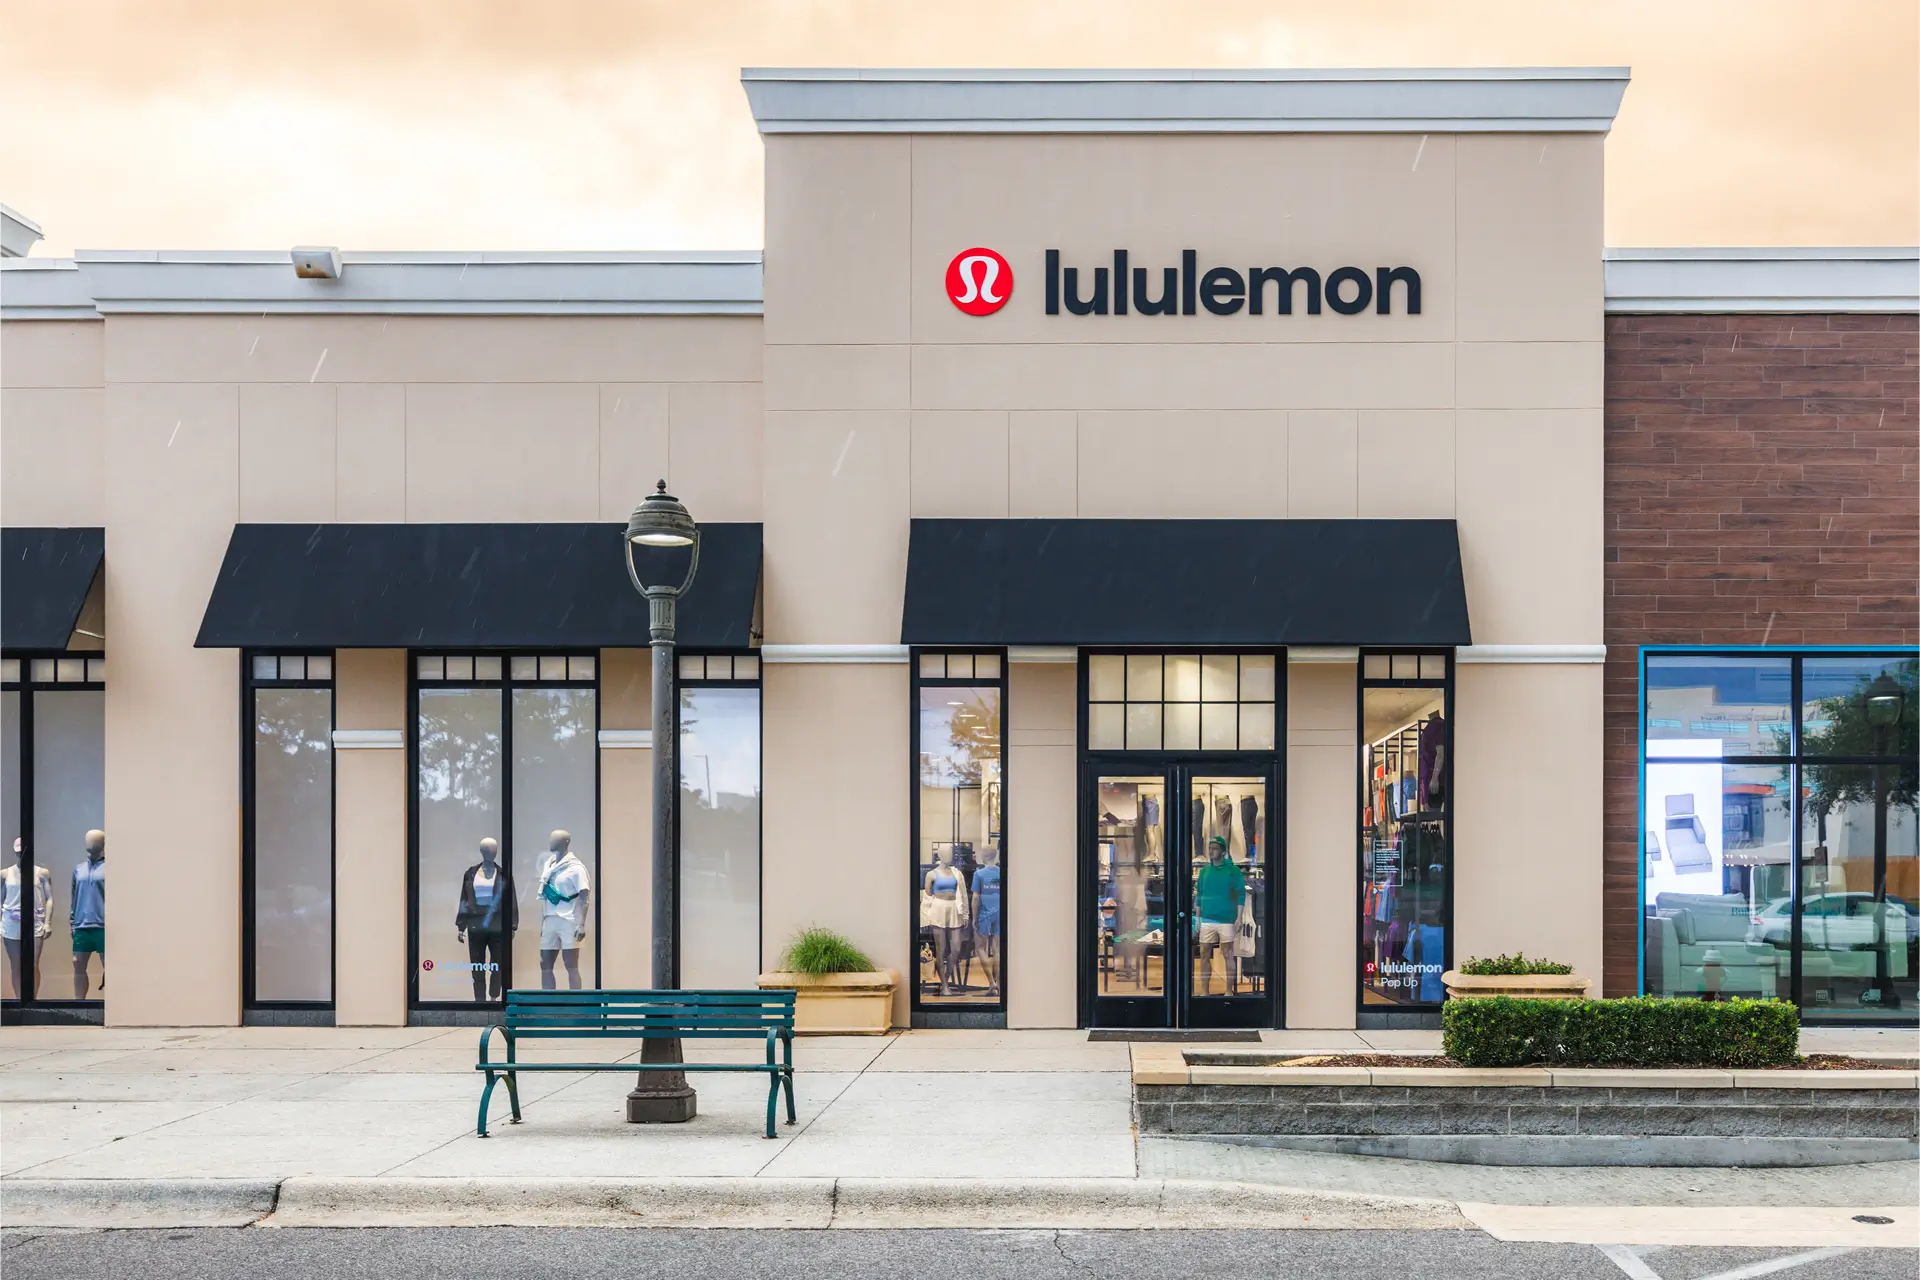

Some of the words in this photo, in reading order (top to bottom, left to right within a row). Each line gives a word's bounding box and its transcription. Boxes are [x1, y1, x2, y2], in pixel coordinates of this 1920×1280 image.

[1045, 249, 1421, 315] lululemon
[1380, 961, 1443, 973] lululemon
[1380, 977, 1401, 989] Pop
[1403, 977, 1419, 989] Up
